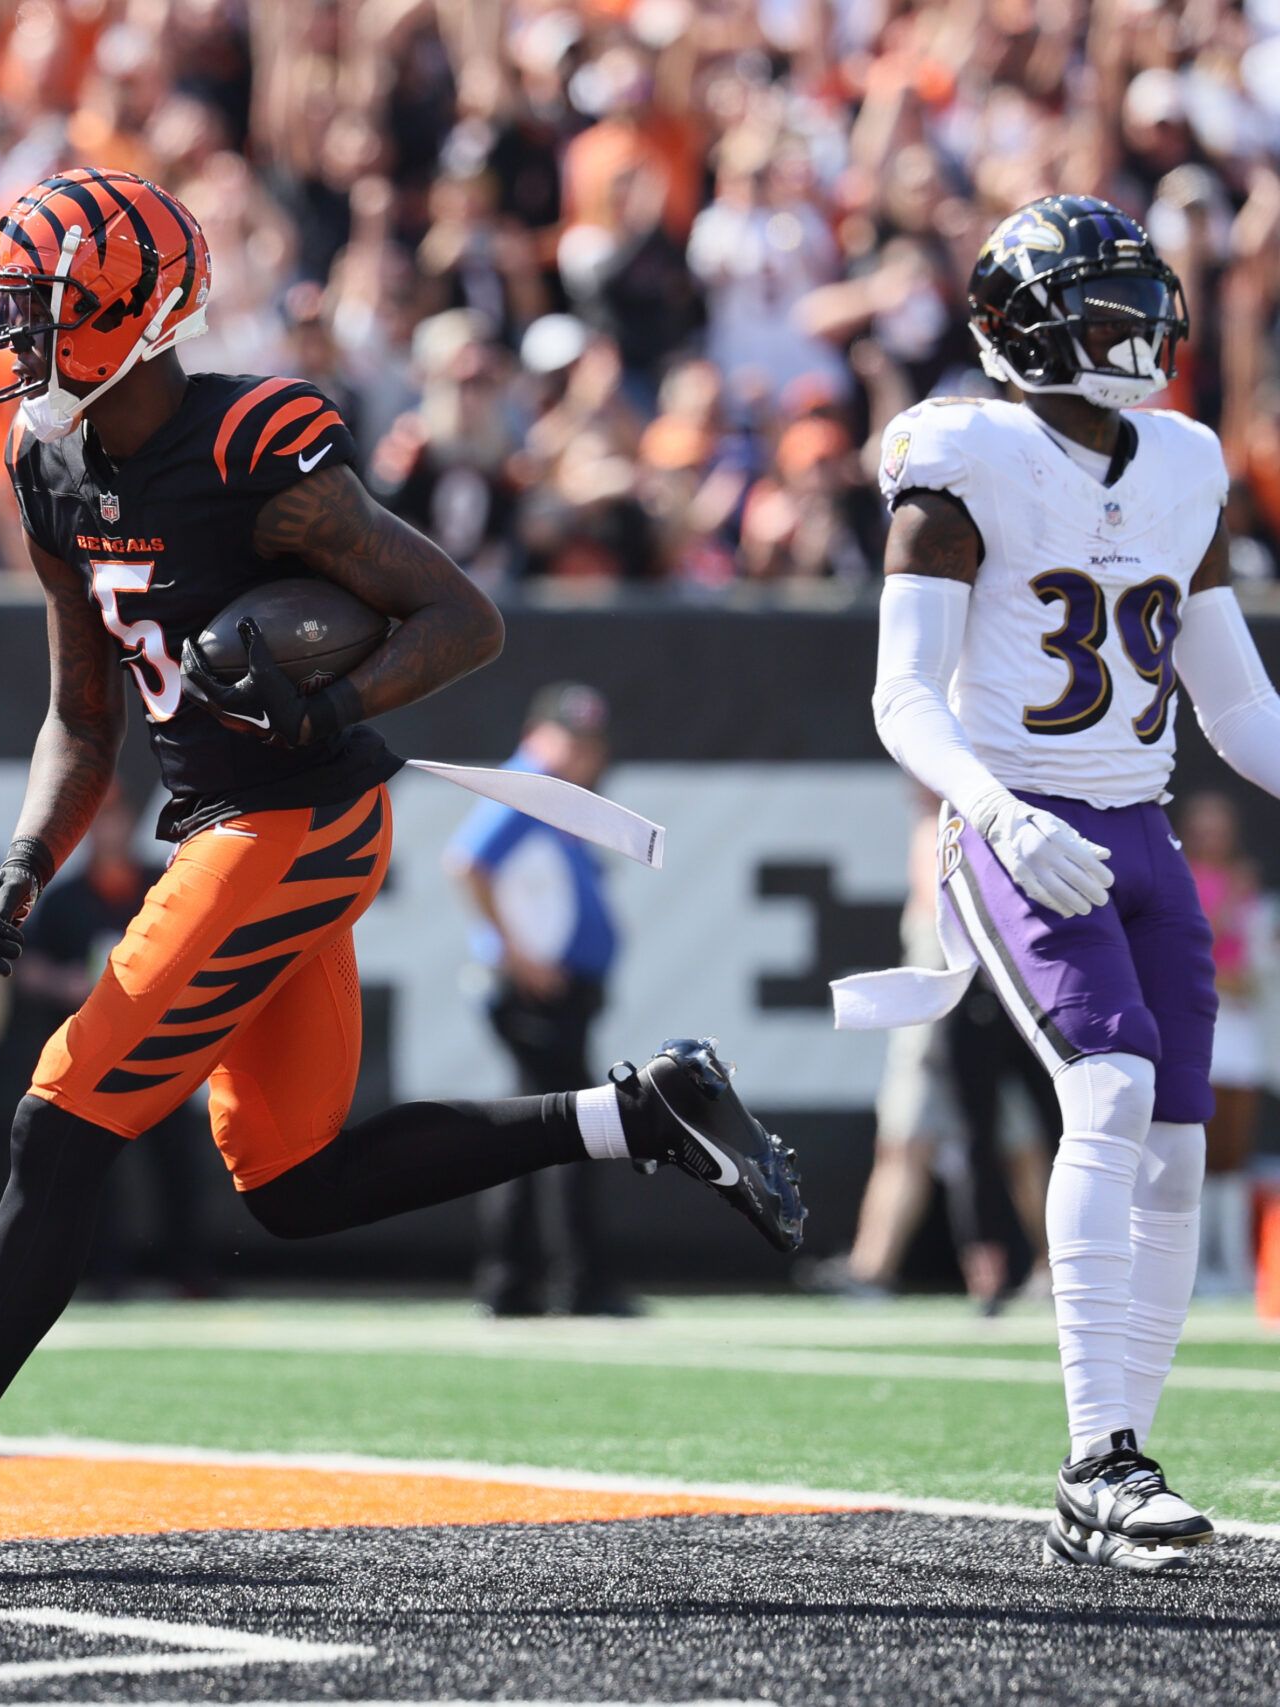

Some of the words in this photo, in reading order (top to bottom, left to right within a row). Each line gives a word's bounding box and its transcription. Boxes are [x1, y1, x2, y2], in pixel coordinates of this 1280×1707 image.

[103, 506, 117, 519] NFL
[77, 535, 164, 552] BENGALS
[1090, 555, 1141, 565] RAVENS
[303, 620, 319, 632] 108
[90, 559, 182, 722] 5
[1022, 567, 1182, 745] 39
